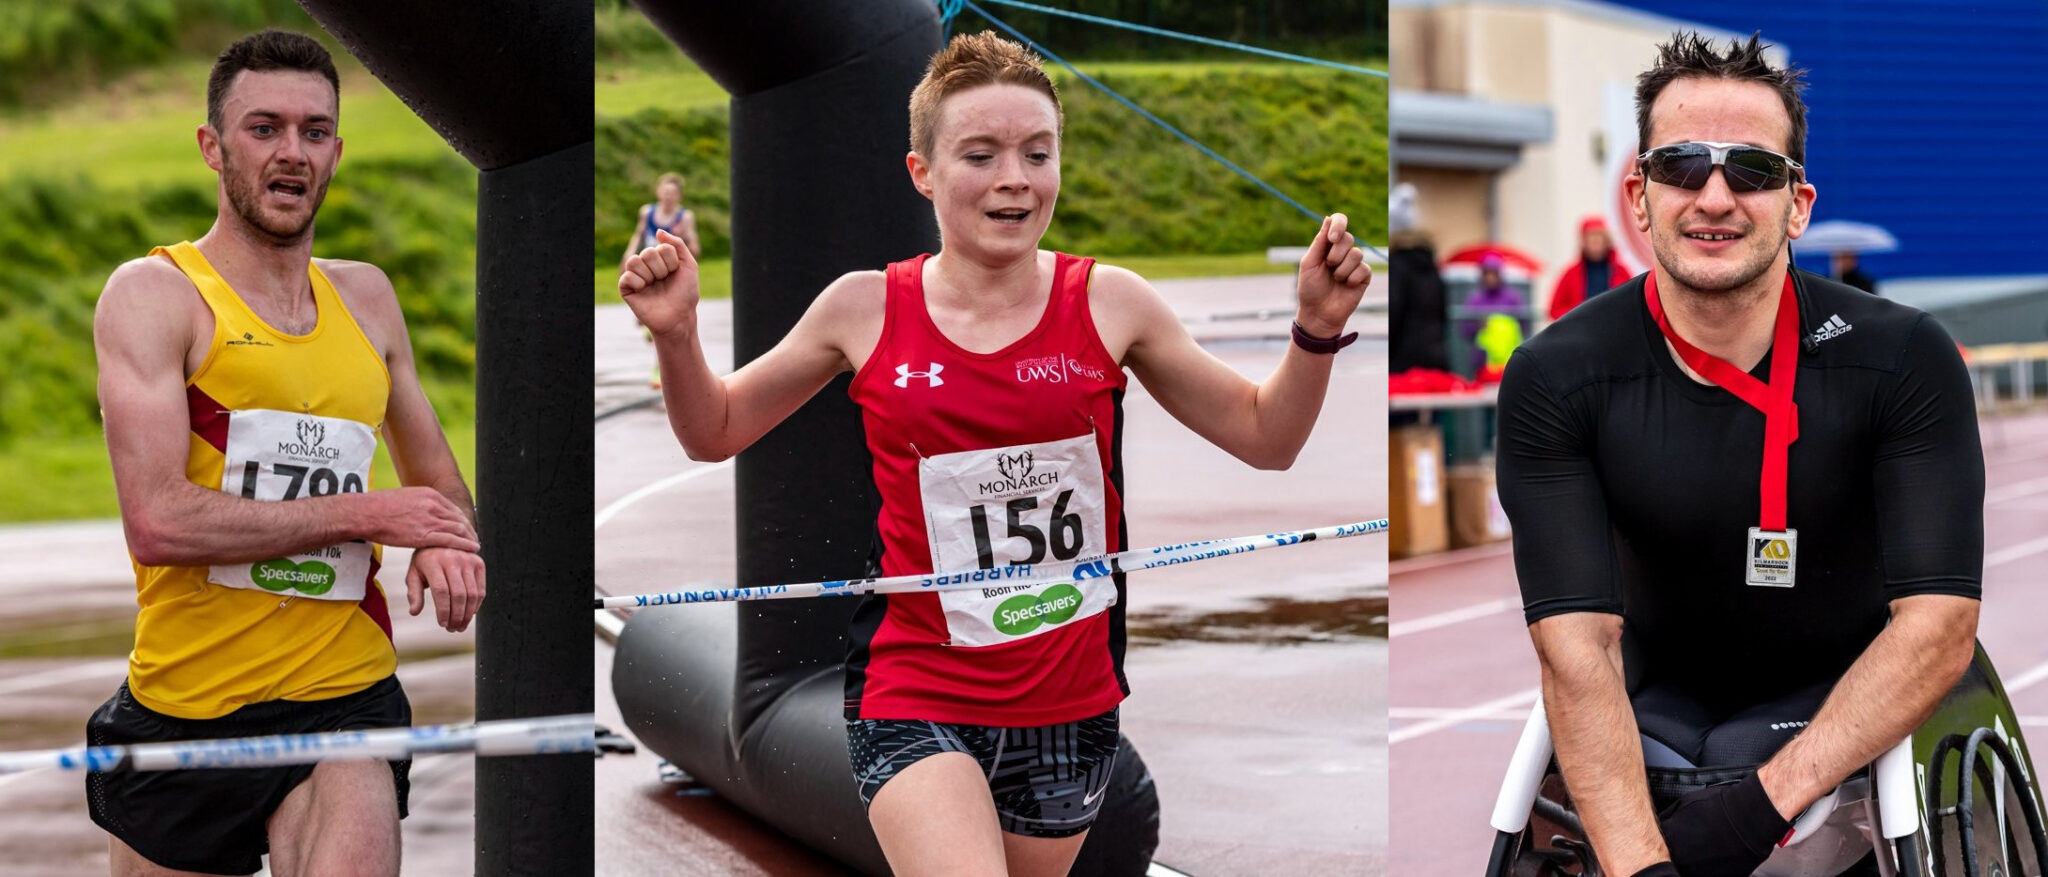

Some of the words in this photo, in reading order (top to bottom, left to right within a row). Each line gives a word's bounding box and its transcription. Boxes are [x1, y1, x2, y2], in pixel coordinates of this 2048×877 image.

[1016, 364, 1062, 383] UWS
[278, 442, 340, 460] MONARCH
[979, 471, 1059, 495] MONARCH
[969, 488, 1084, 570] 156
[259, 564, 329, 585] Specsavers
[1001, 594, 1077, 626] Specsavers
